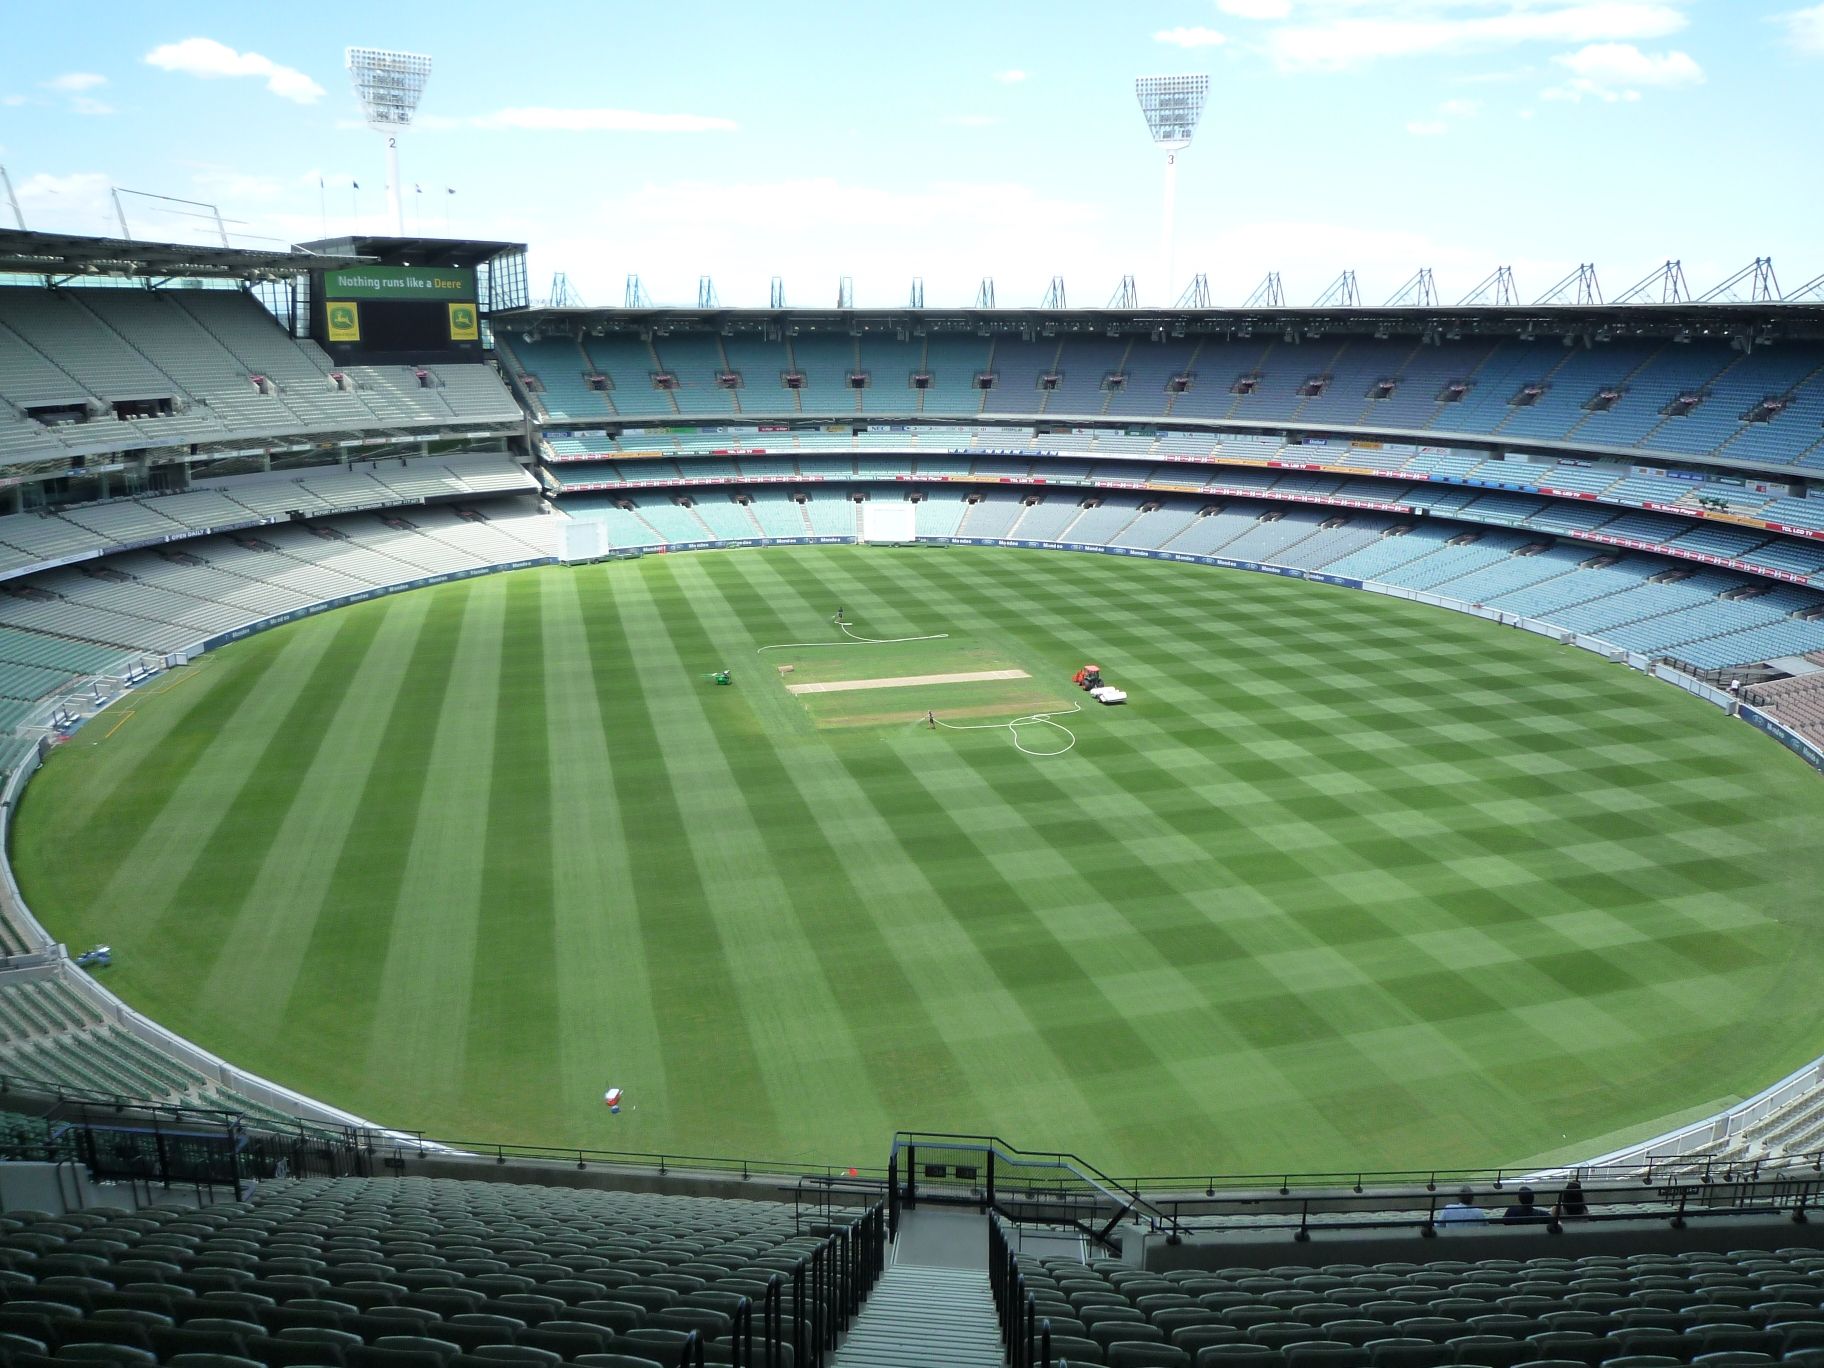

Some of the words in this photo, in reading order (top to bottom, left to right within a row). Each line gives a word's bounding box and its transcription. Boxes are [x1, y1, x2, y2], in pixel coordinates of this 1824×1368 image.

[388, 137, 397, 148] 2
[1167, 154, 1175, 165] 3
[338, 275, 380, 289] Nothing
[382, 279, 405, 288] runs
[406, 277, 424, 288] like
[426, 280, 432, 288] a
[434, 278, 462, 289] Deere
[187, 529, 204, 537] DAILY
